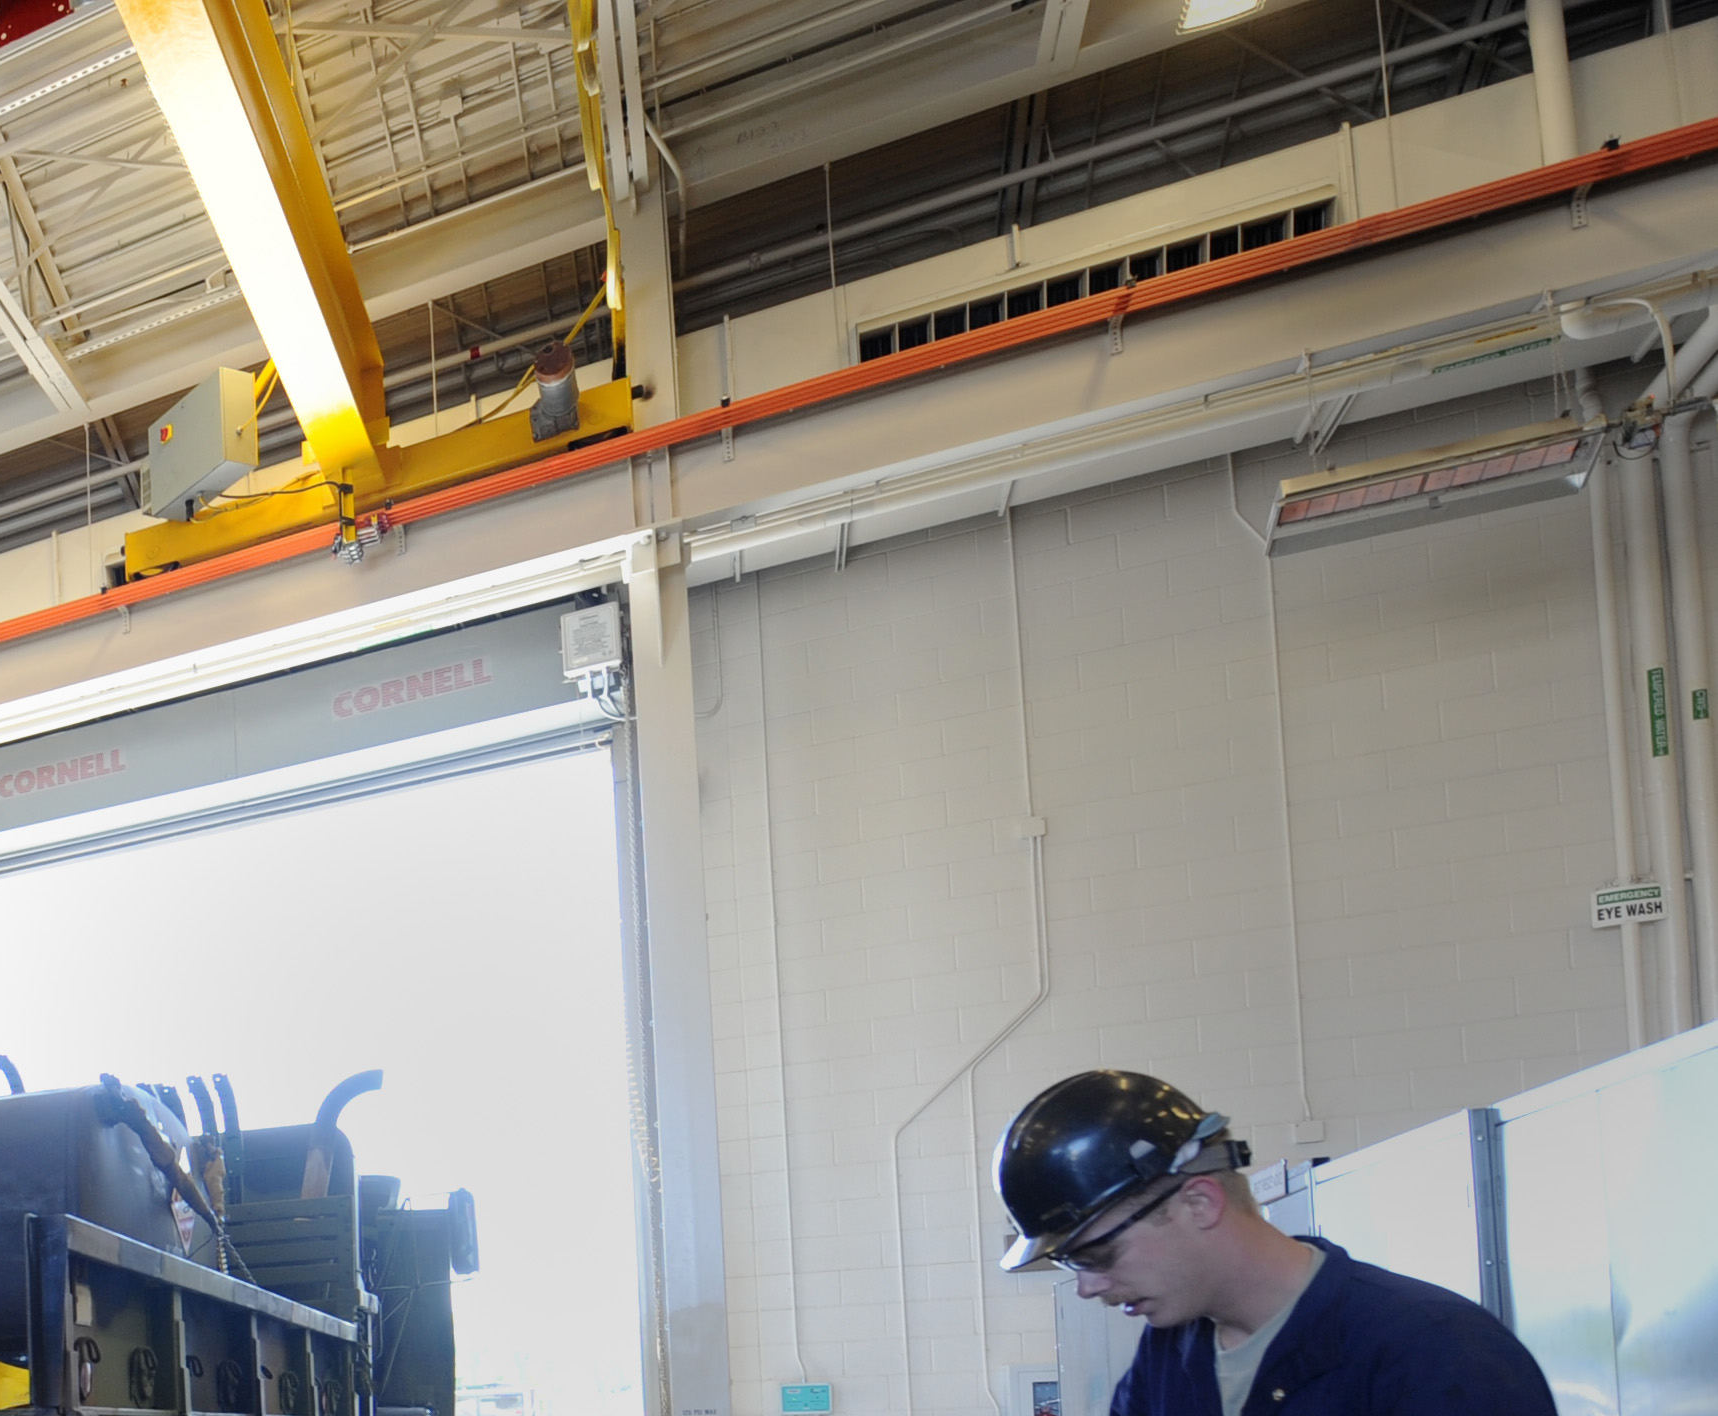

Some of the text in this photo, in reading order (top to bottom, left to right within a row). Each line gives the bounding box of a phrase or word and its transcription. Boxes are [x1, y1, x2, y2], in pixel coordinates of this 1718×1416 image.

[332, 659, 492, 718] CORNELL
[1651, 669, 1667, 748] TEMPERED WATER
[1597, 901, 1663, 921] EYE WASH
[1598, 888, 1660, 904] EMERGENCY
